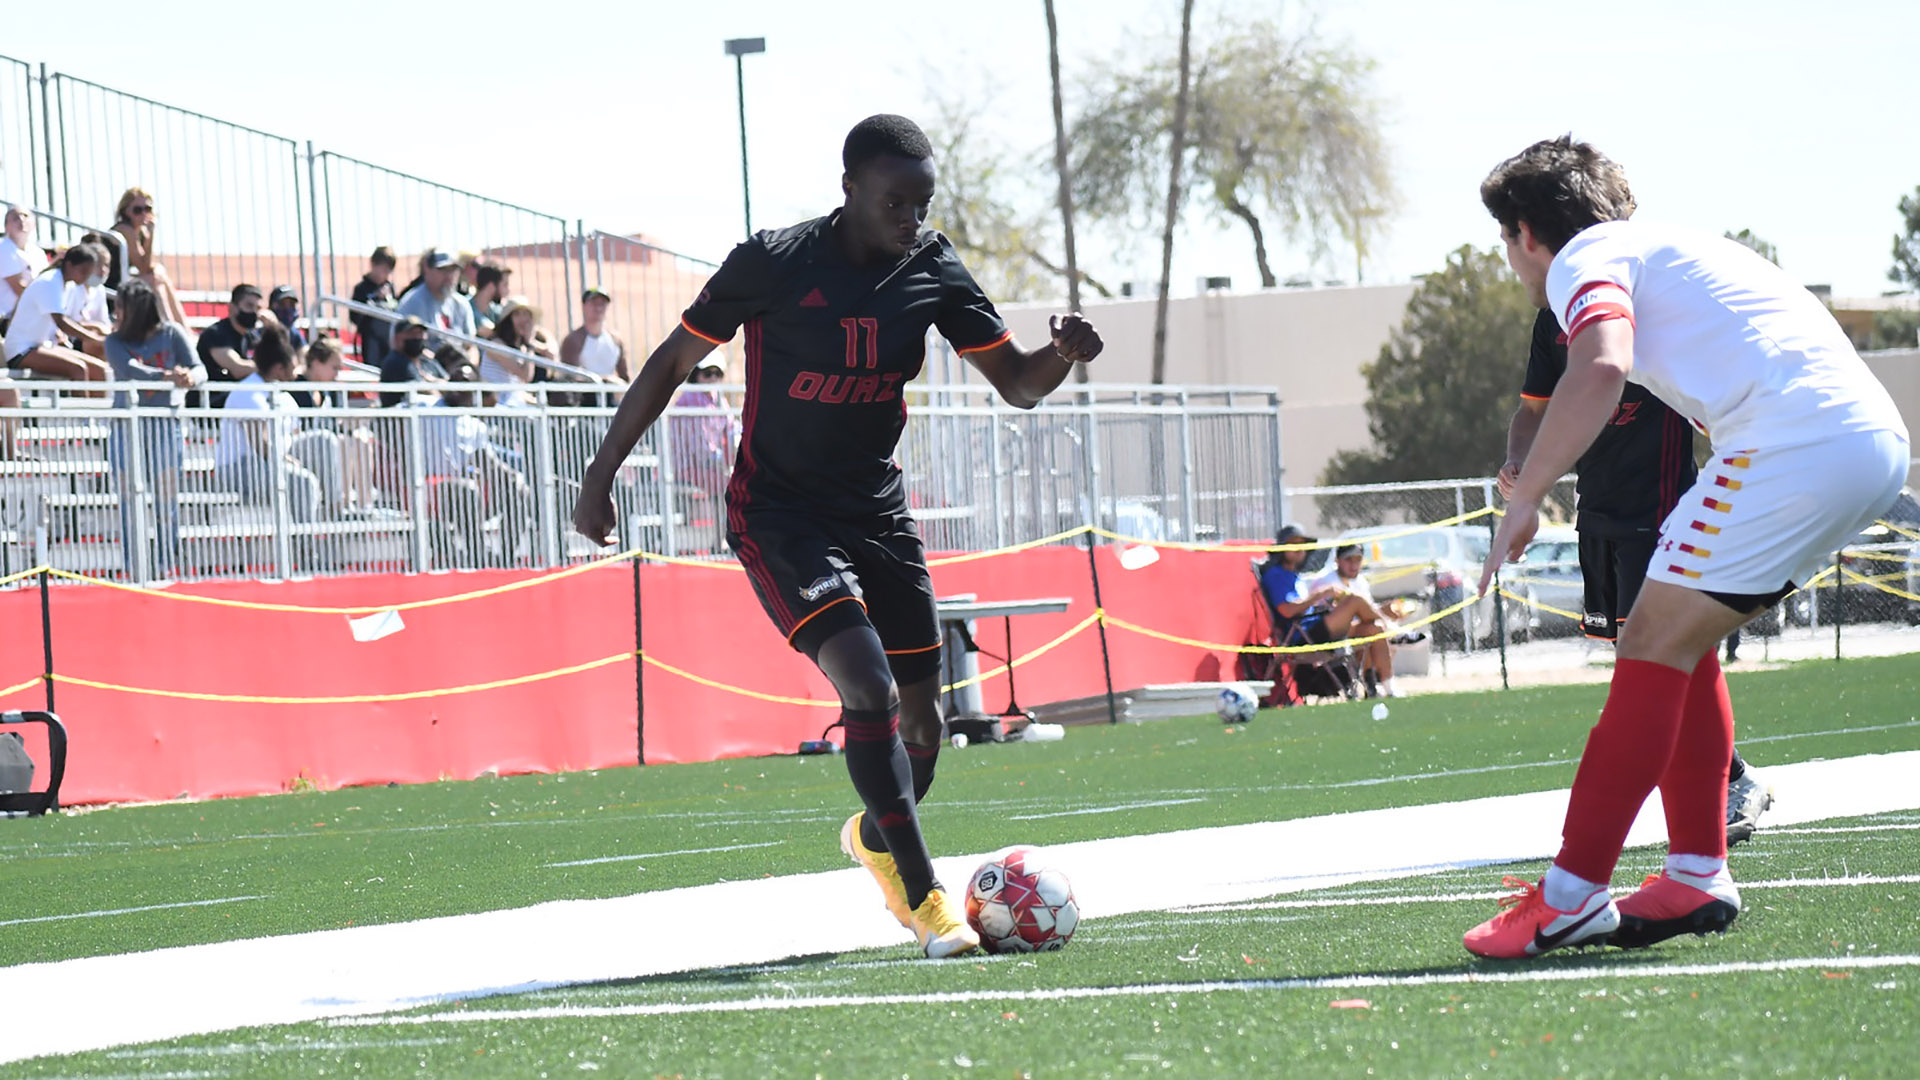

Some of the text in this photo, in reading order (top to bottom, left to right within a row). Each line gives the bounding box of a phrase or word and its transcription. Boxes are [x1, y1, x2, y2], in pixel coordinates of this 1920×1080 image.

[1570, 294, 1598, 318] TAIN
[840, 318, 878, 369] 11
[808, 578, 838, 600] SPIRIT
